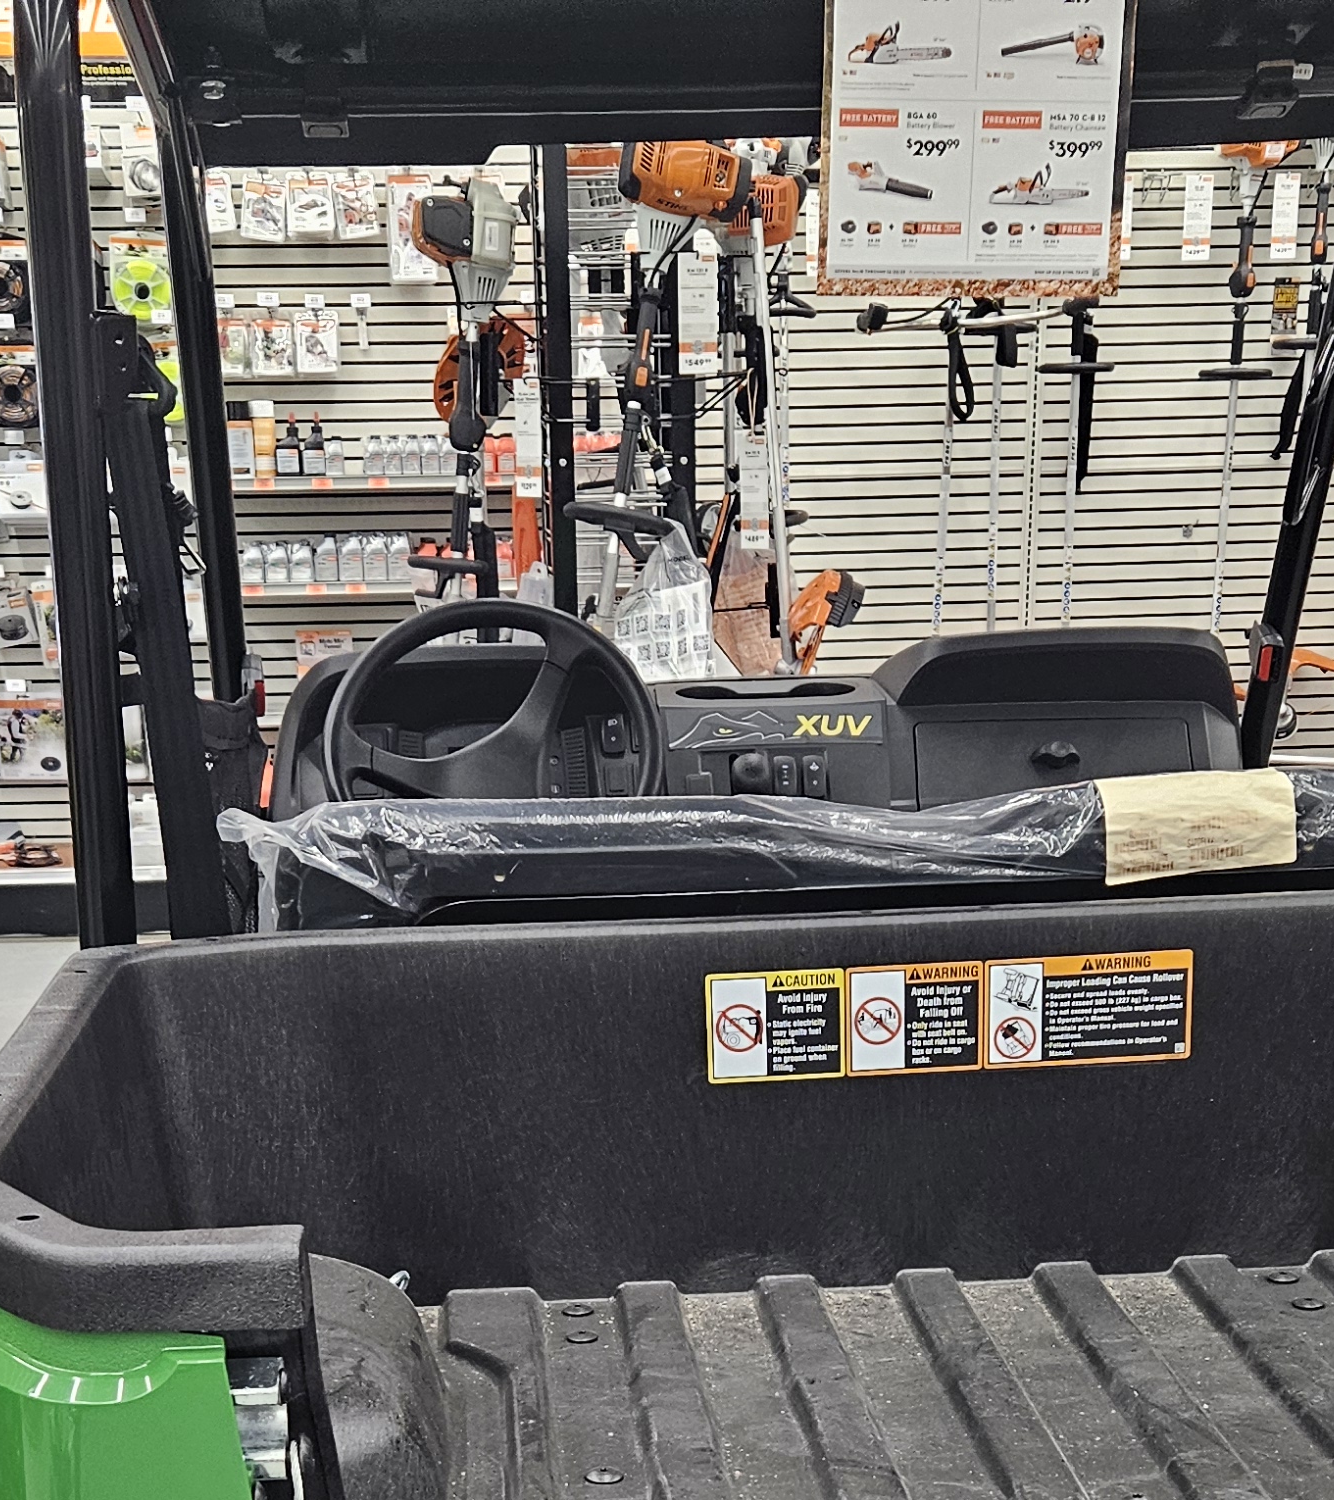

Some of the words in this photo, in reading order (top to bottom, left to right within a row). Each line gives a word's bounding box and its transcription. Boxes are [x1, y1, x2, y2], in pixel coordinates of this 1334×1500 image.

[841, 114, 860, 122] FREE
[862, 114, 897, 123] BATTERY
[984, 116, 1004, 124] FREE
[1005, 116, 1041, 125] BATTERY
[1069, 114, 1079, 122] 70
[920, 223, 942, 232] FREE
[1061, 225, 1083, 234] FREE
[792, 714, 873, 737] XUV
[1095, 956, 1151, 970] WARNING
[922, 965, 979, 980] WARNING
[785, 973, 835, 987] CAUTION
[1046, 978, 1080, 989] Improper
[1082, 976, 1111, 986] Loading
[1113, 975, 1127, 985] Can
[1129, 974, 1151, 983] Cause
[1152, 973, 1184, 982] Rollover
[911, 986, 934, 996] Avoid
[936, 985, 960, 996] Injury
[962, 985, 972, 994] or
[777, 993, 801, 1003] Avoid
[803, 992, 827, 1003] Injury
[1050, 992, 1071, 1000] Secure
[917, 997, 942, 1007] Death
[782, 1005, 804, 1014] From
[806, 1004, 823, 1013] Fire
[919, 1008, 949, 1018] Falling
[950, 1006, 963, 1016] Off
[773, 1020, 792, 1028] Static
[793, 1019, 826, 1027] electricity
[912, 1021, 928, 1030] Only
[944, 1020, 952, 1028] in
[935, 1038, 948, 1046] ride
[949, 1037, 956, 1045] in
[957, 1036, 976, 1045] cargo
[773, 1046, 792, 1054] Place
[807, 1044, 839, 1053] container
[943, 1046, 962, 1055] cargo
[783, 1054, 807, 1064] ground
